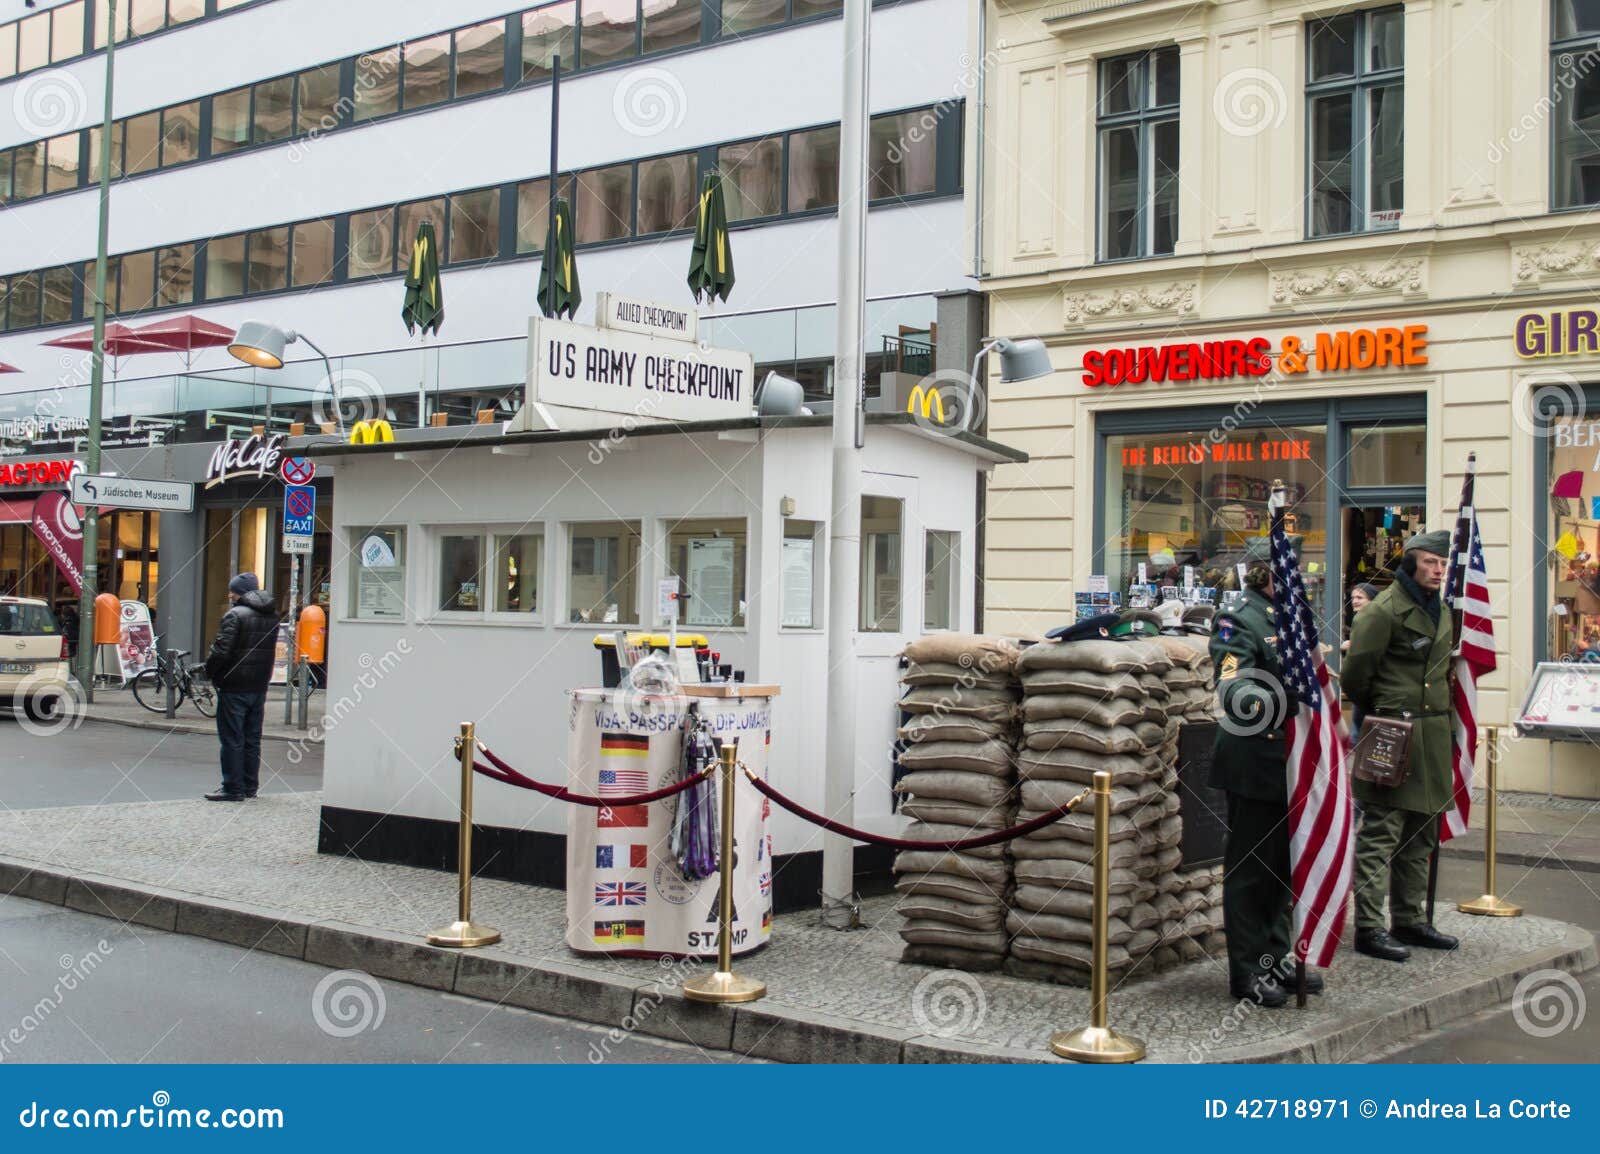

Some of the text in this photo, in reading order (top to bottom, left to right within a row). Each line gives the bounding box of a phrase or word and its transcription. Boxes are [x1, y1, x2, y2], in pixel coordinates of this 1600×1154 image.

[616, 301, 689, 332] ALLIED CHECKPOINT
[1513, 309, 1600, 359] GIR
[549, 340, 744, 403] US ARMY CHECKPOINT
[1082, 325, 1429, 387] SOUVENIRS & MORE
[206, 433, 283, 484] McCafé
[1121, 440, 1312, 467] THE BERLIN WALL STORE
[103, 486, 180, 501] Jüdisches Museum
